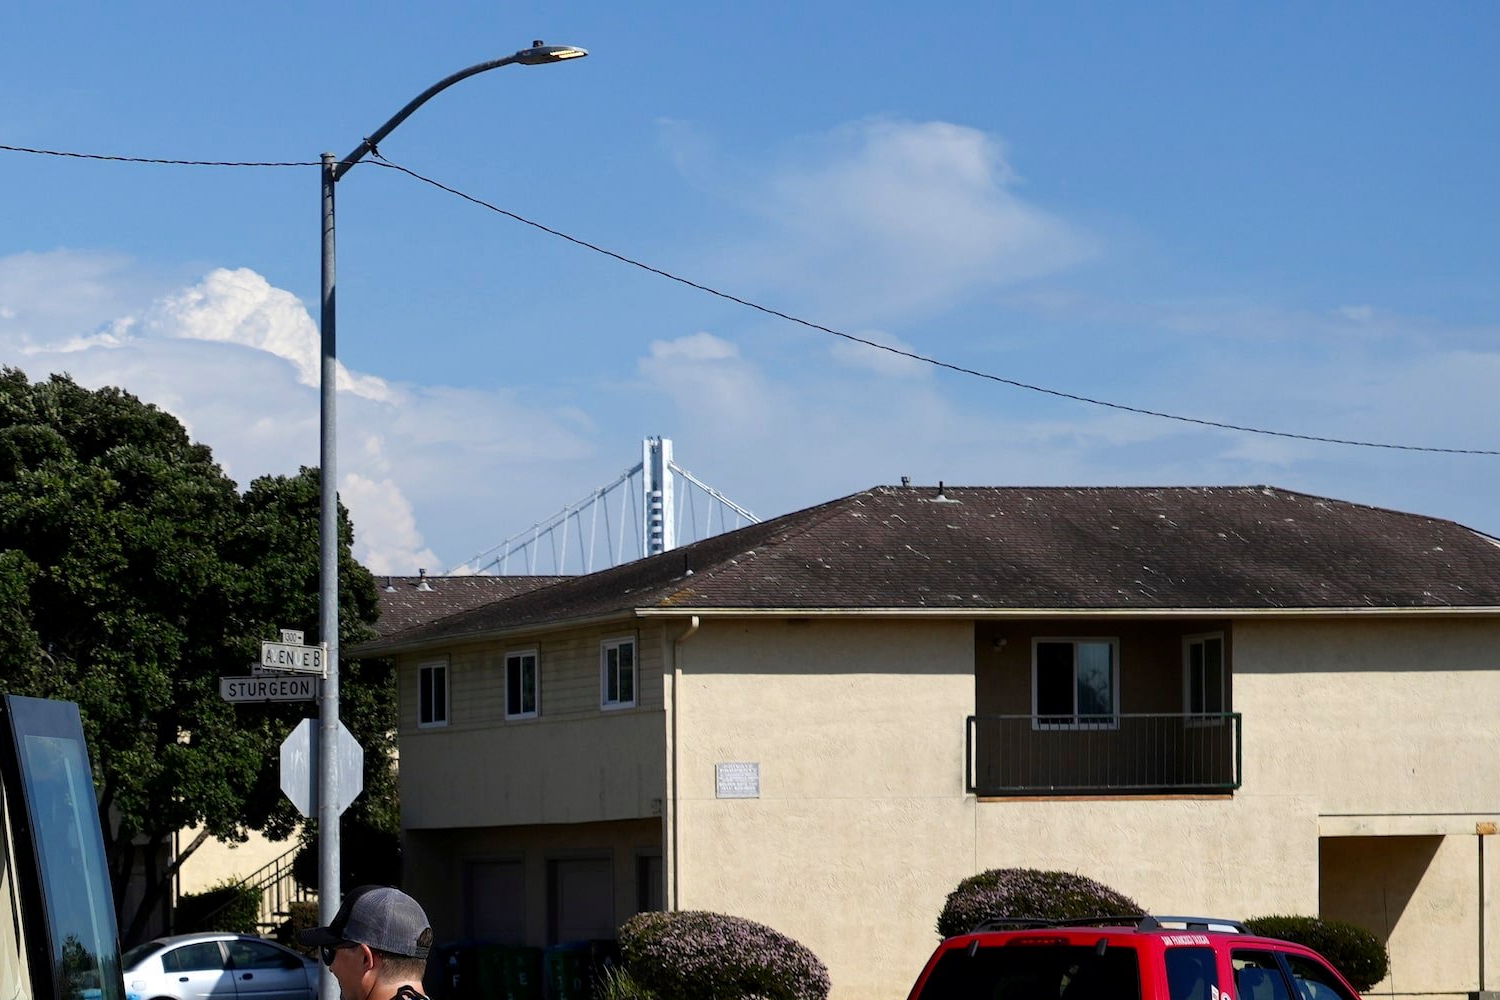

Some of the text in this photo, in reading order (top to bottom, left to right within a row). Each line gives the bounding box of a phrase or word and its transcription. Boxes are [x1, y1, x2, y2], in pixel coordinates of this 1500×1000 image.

[285, 632, 297, 642] 1300
[313, 650, 321, 667] B
[229, 680, 310, 697] STURGEON
